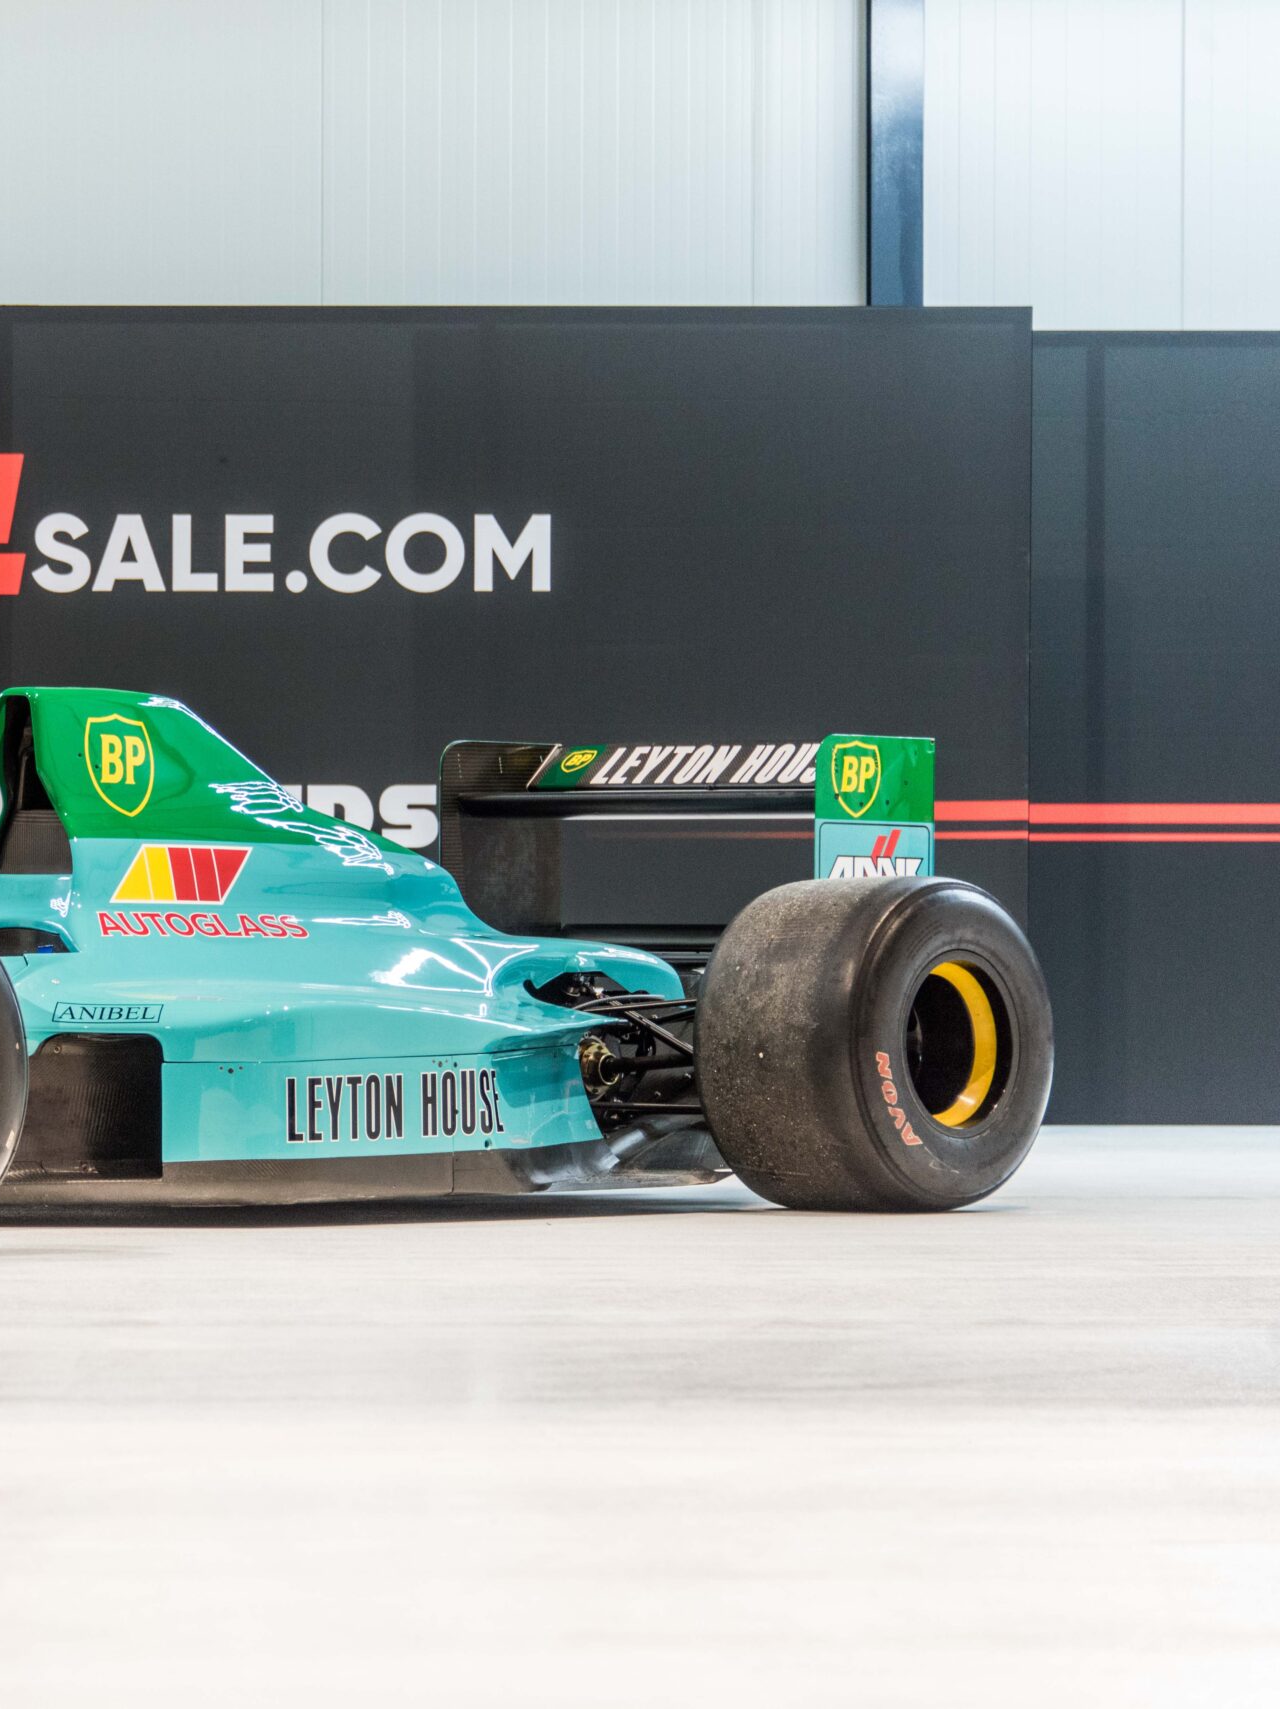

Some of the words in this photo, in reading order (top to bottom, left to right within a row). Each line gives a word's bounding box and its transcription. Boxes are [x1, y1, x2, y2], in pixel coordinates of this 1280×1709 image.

[99, 733, 146, 785] BP
[565, 754, 593, 766] BP
[590, 744, 743, 785] LEYTON
[728, 743, 819, 784] HOU
[841, 756, 876, 793] BP
[95, 911, 309, 939] AUTOGLASS
[58, 1005, 156, 1021] ANIBEL
[286, 1073, 404, 1143] LEYTON
[421, 1068, 505, 1137] HOUSE
[875, 1051, 924, 1146] AVON
